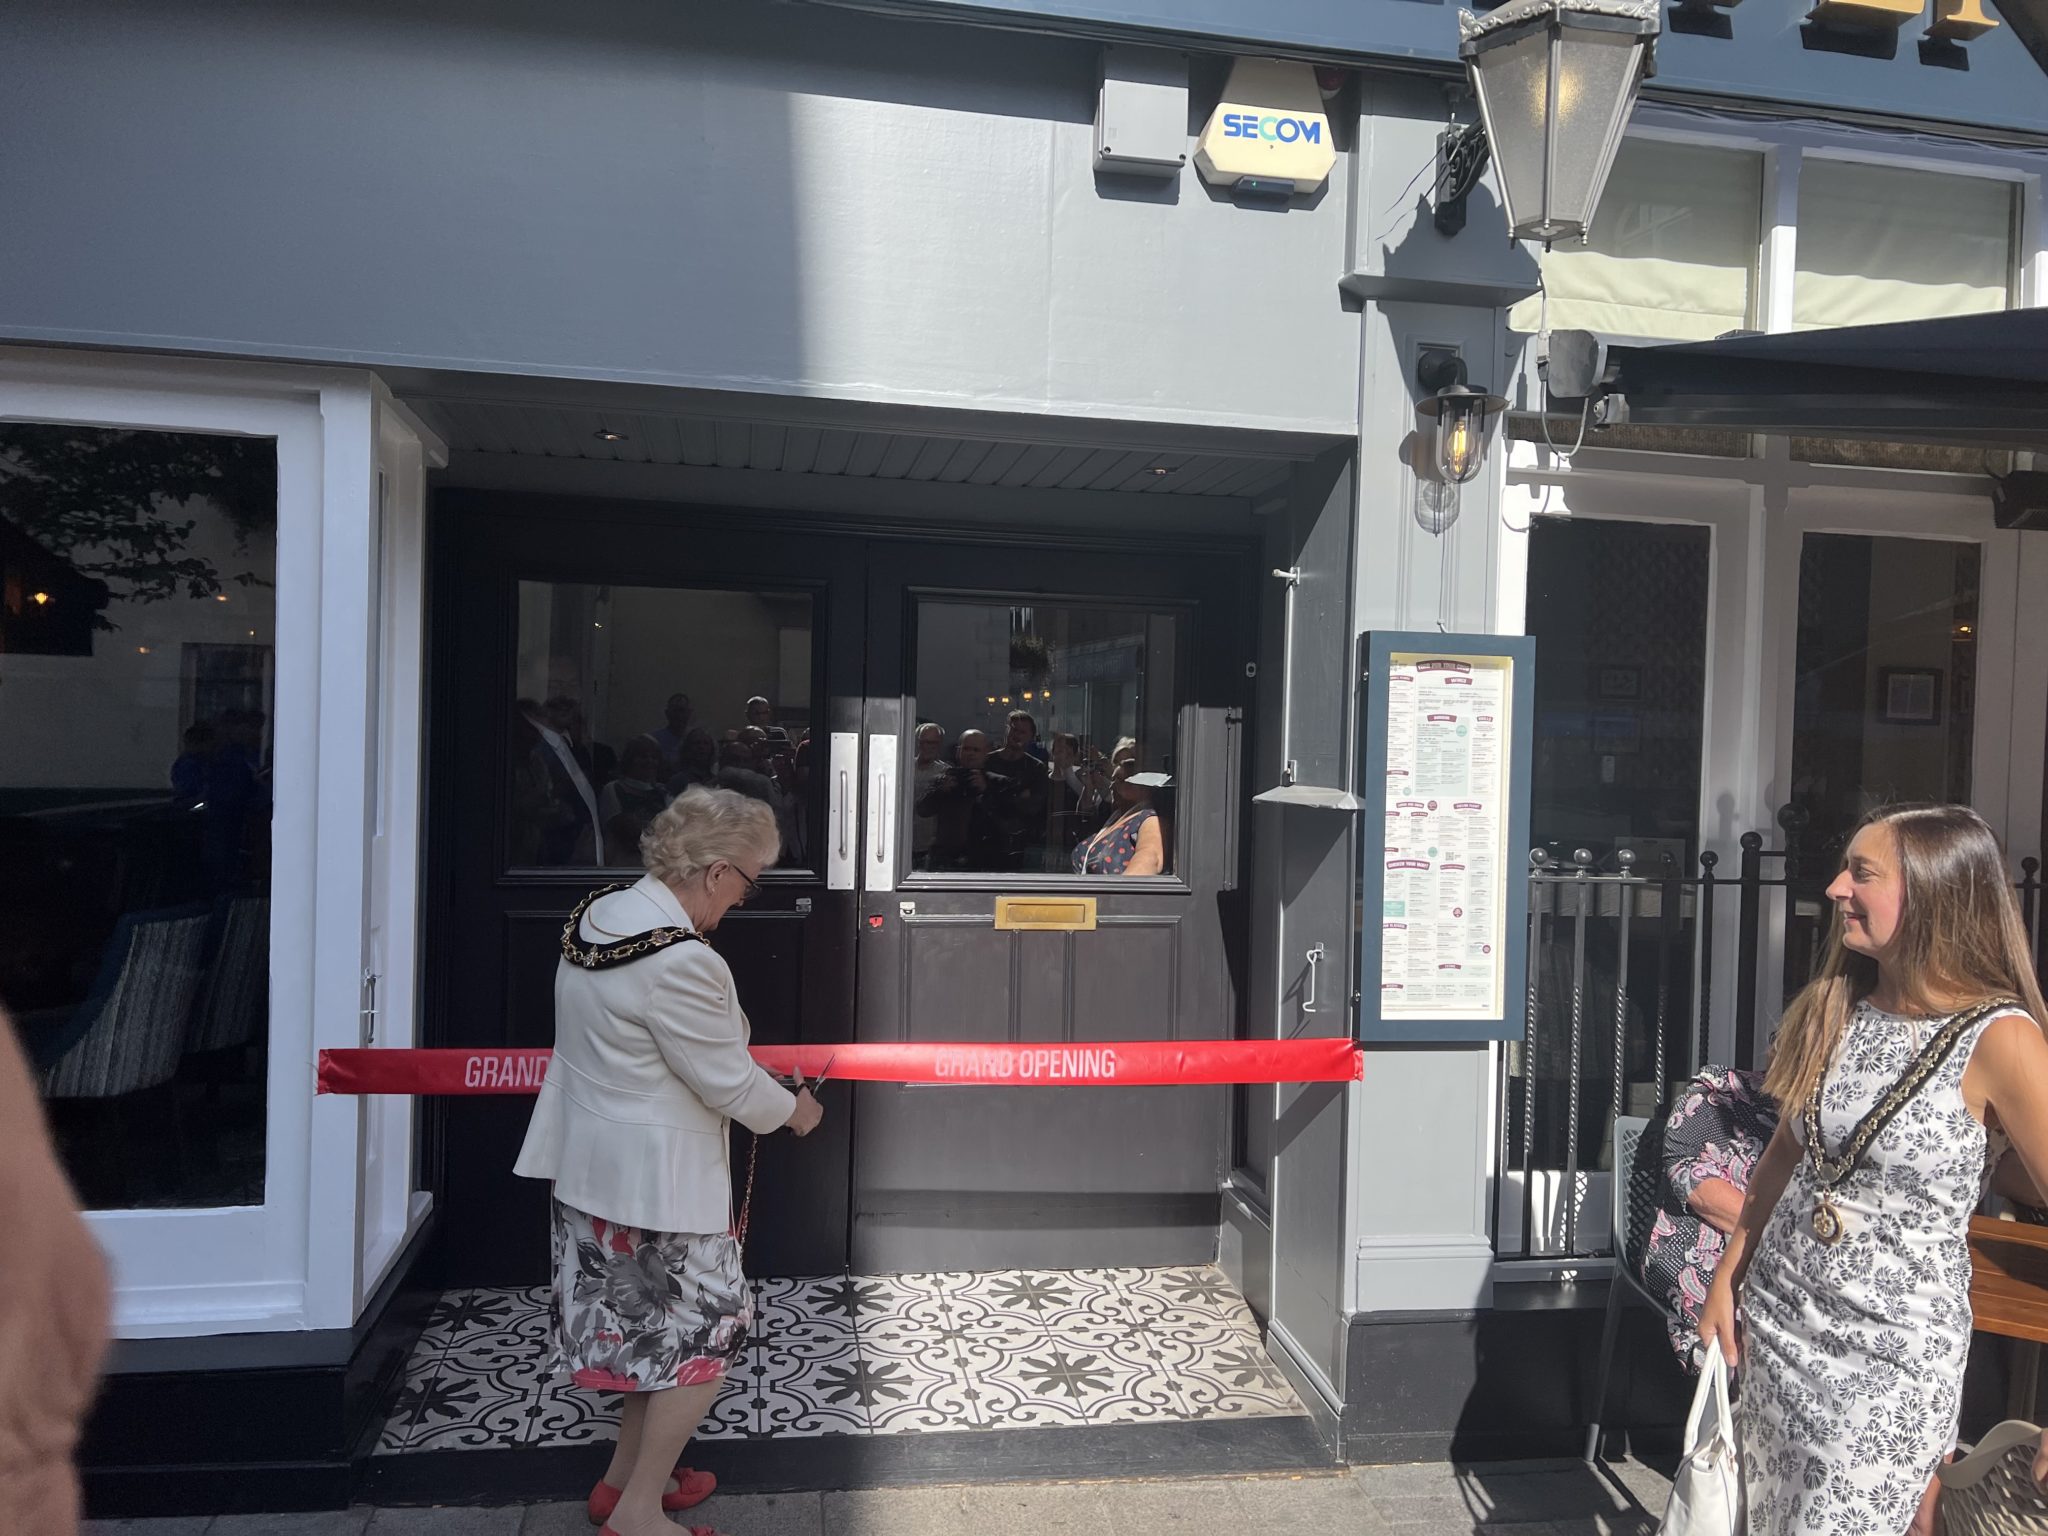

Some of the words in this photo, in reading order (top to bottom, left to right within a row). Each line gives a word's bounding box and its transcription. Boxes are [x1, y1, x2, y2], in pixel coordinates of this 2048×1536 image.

[1223, 113, 1321, 144] SECOM
[935, 1048, 1013, 1077] GRAND
[1018, 1049, 1116, 1078] OPENING
